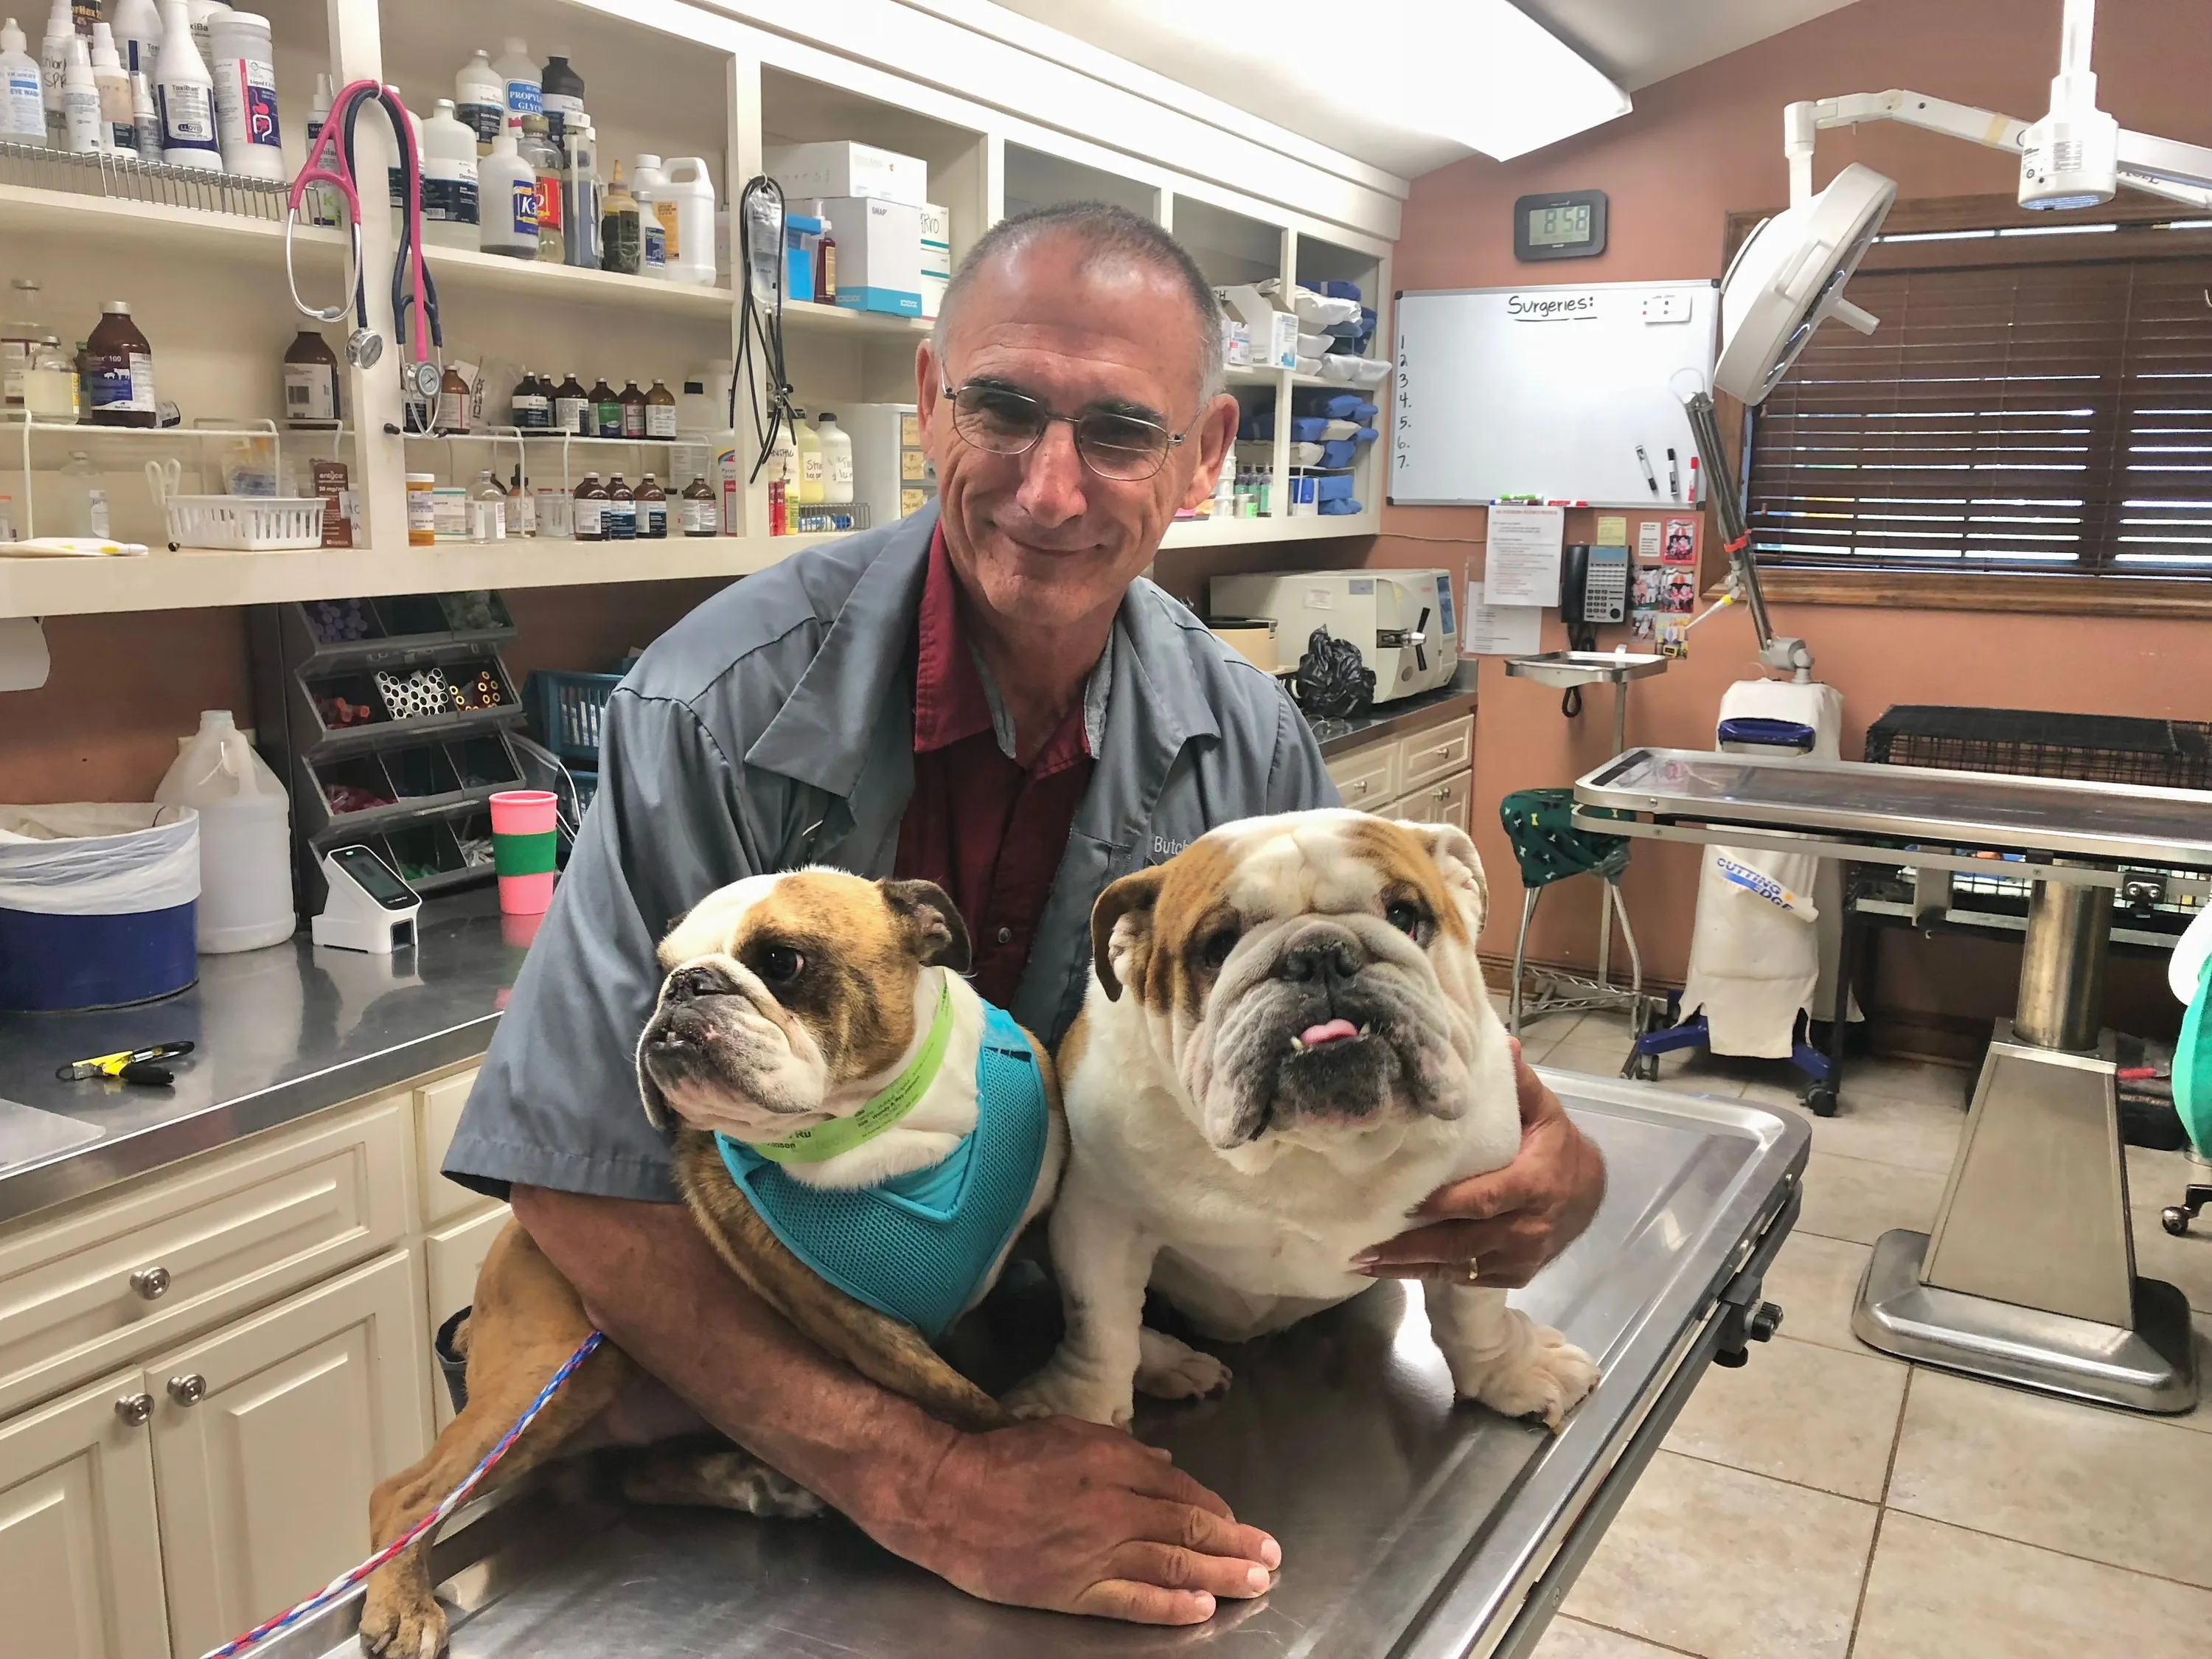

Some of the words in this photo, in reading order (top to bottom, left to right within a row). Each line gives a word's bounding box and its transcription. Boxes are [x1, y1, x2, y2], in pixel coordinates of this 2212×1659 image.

[509, 91, 543, 103] PROPYLE
[518, 101, 543, 114] GLYCO
[1507, 295, 1593, 317] Surgeries:
[1399, 354, 1408, 367] 2
[1399, 373, 1409, 388] 3
[1399, 392, 1412, 408] 4.
[1399, 416, 1411, 430] 5.
[1397, 435, 1410, 449] 6.
[1397, 455, 1409, 469] 7.
[1717, 858, 1781, 895] CUTTING
